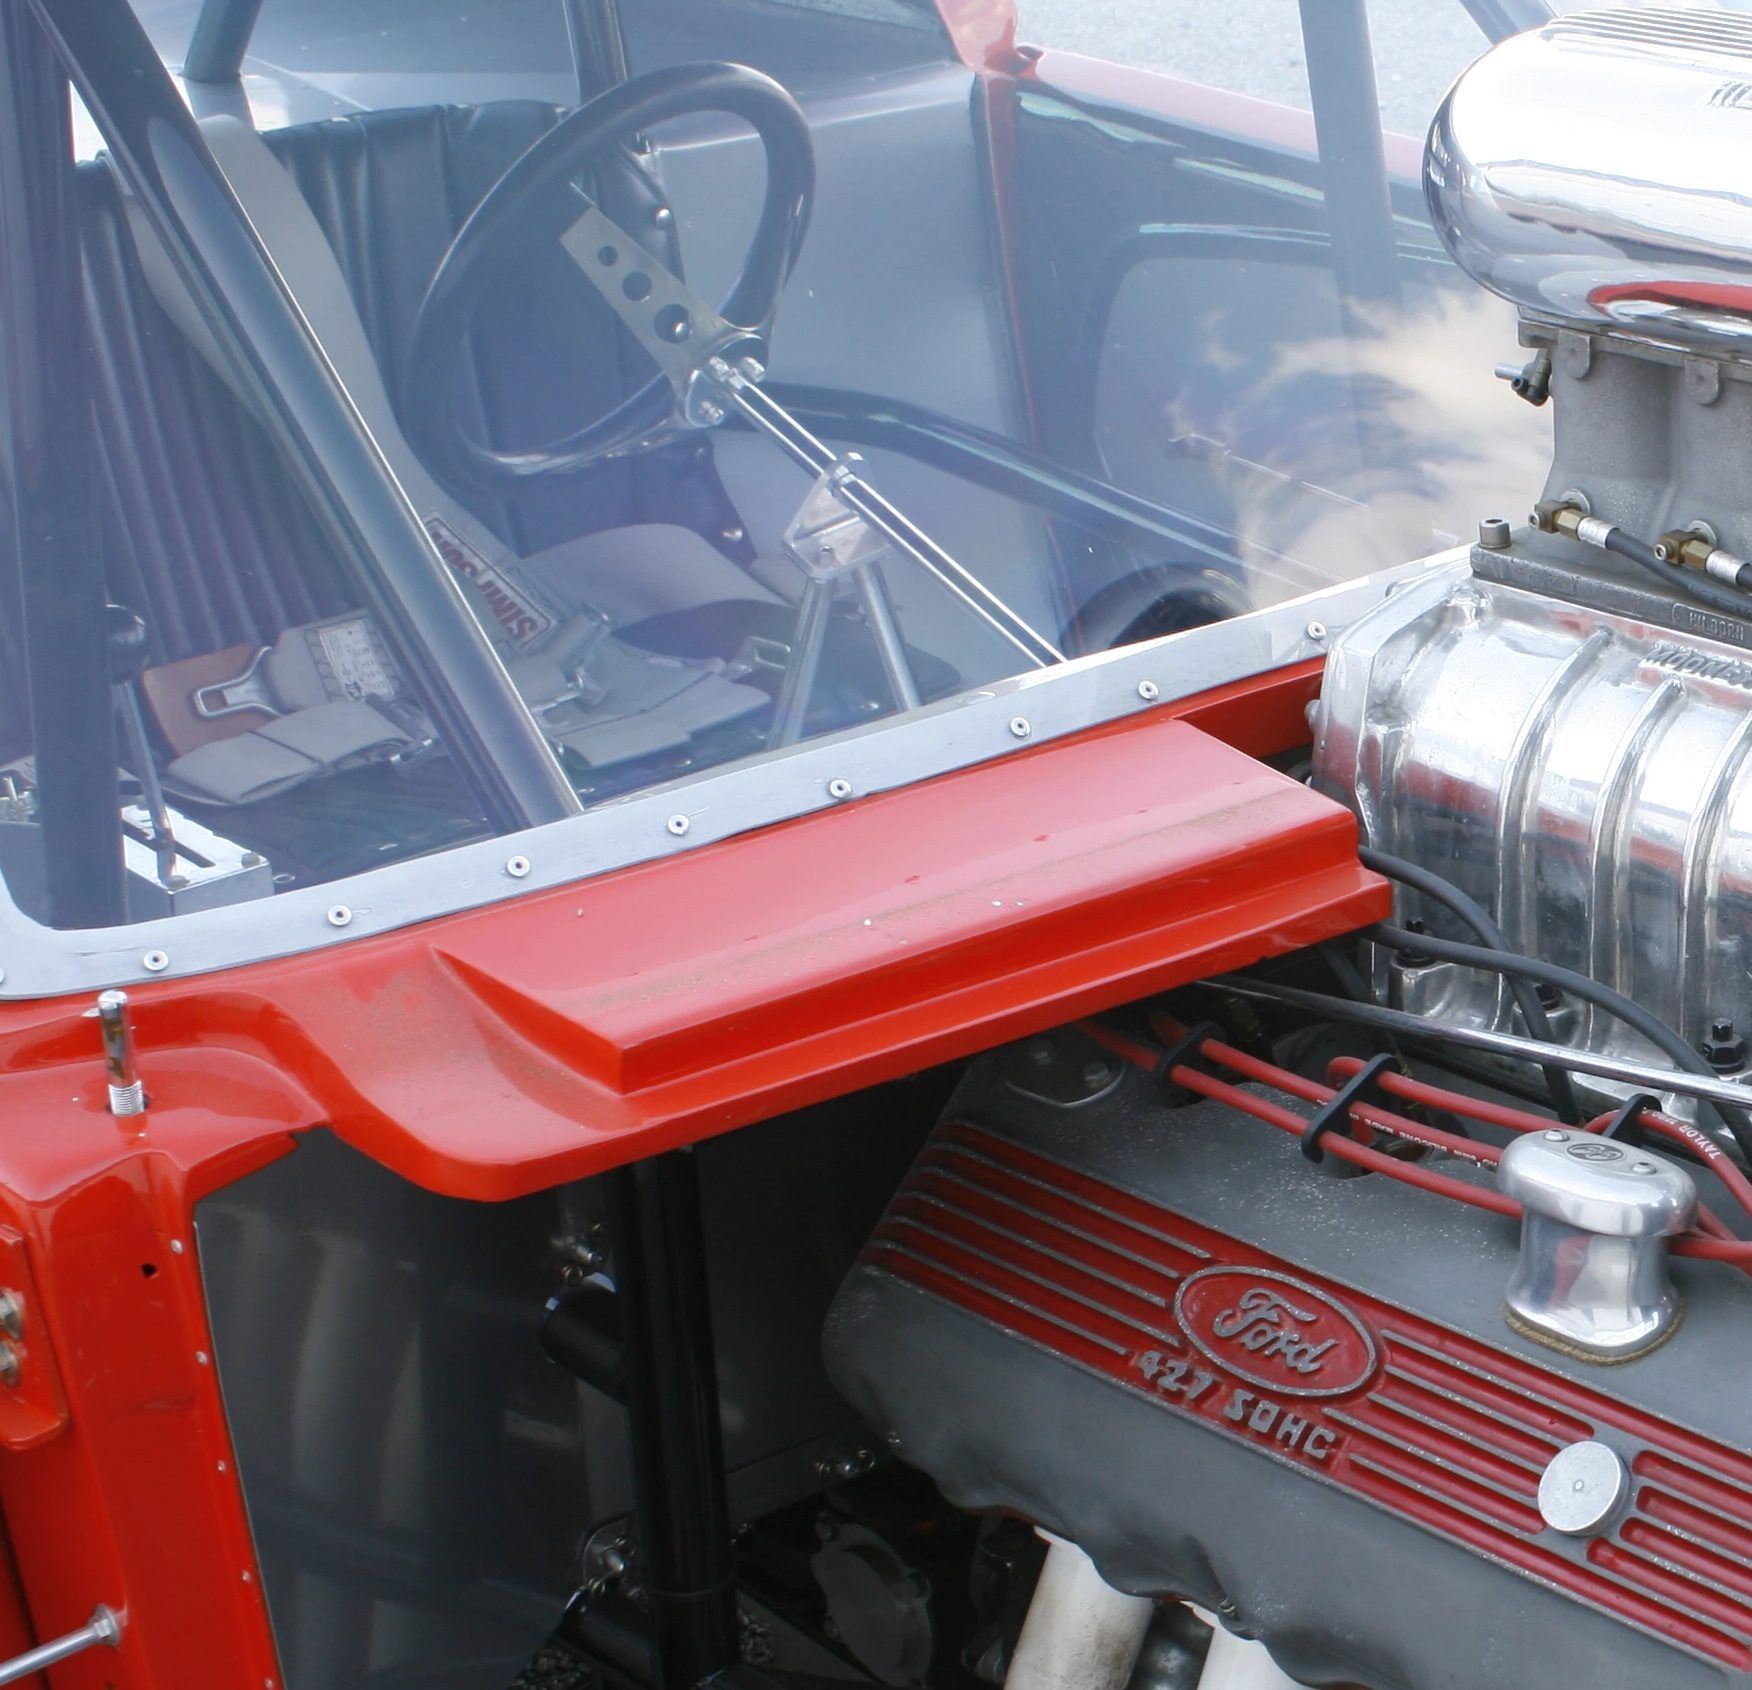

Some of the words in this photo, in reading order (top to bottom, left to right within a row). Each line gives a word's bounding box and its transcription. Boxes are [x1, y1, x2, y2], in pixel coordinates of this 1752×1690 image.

[1688, 611, 1745, 641] HILBORN
[1678, 1124, 1721, 1160] TAYLOR
[1212, 1287, 1340, 1373] Ford
[1138, 1351, 1215, 1400] 427
[1221, 1387, 1336, 1460] SOHC
